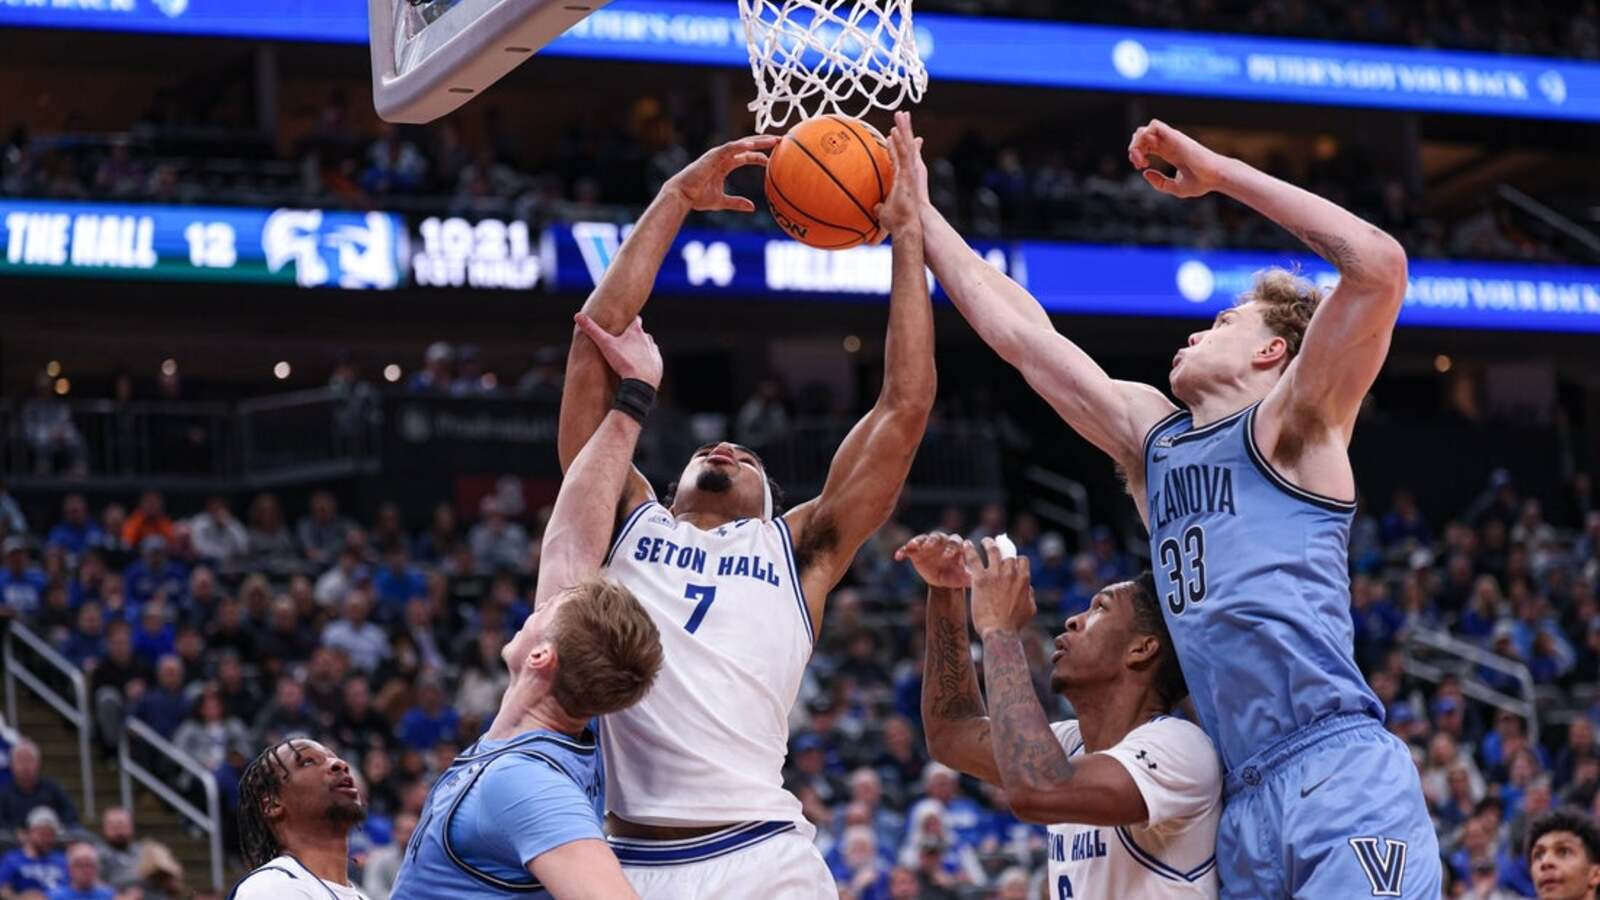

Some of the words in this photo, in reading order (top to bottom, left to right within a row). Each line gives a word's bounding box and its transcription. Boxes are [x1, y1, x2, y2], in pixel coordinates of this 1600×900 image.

[6, 212, 71, 264] THE
[71, 214, 157, 268] HALL
[682, 240, 736, 287] 14
[634, 536, 707, 575] SETON
[717, 555, 780, 588] HALL
[1159, 523, 1207, 617] 33
[683, 582, 717, 635] 7
[1071, 829, 1107, 862] HALL
[1348, 836, 1408, 897] V
